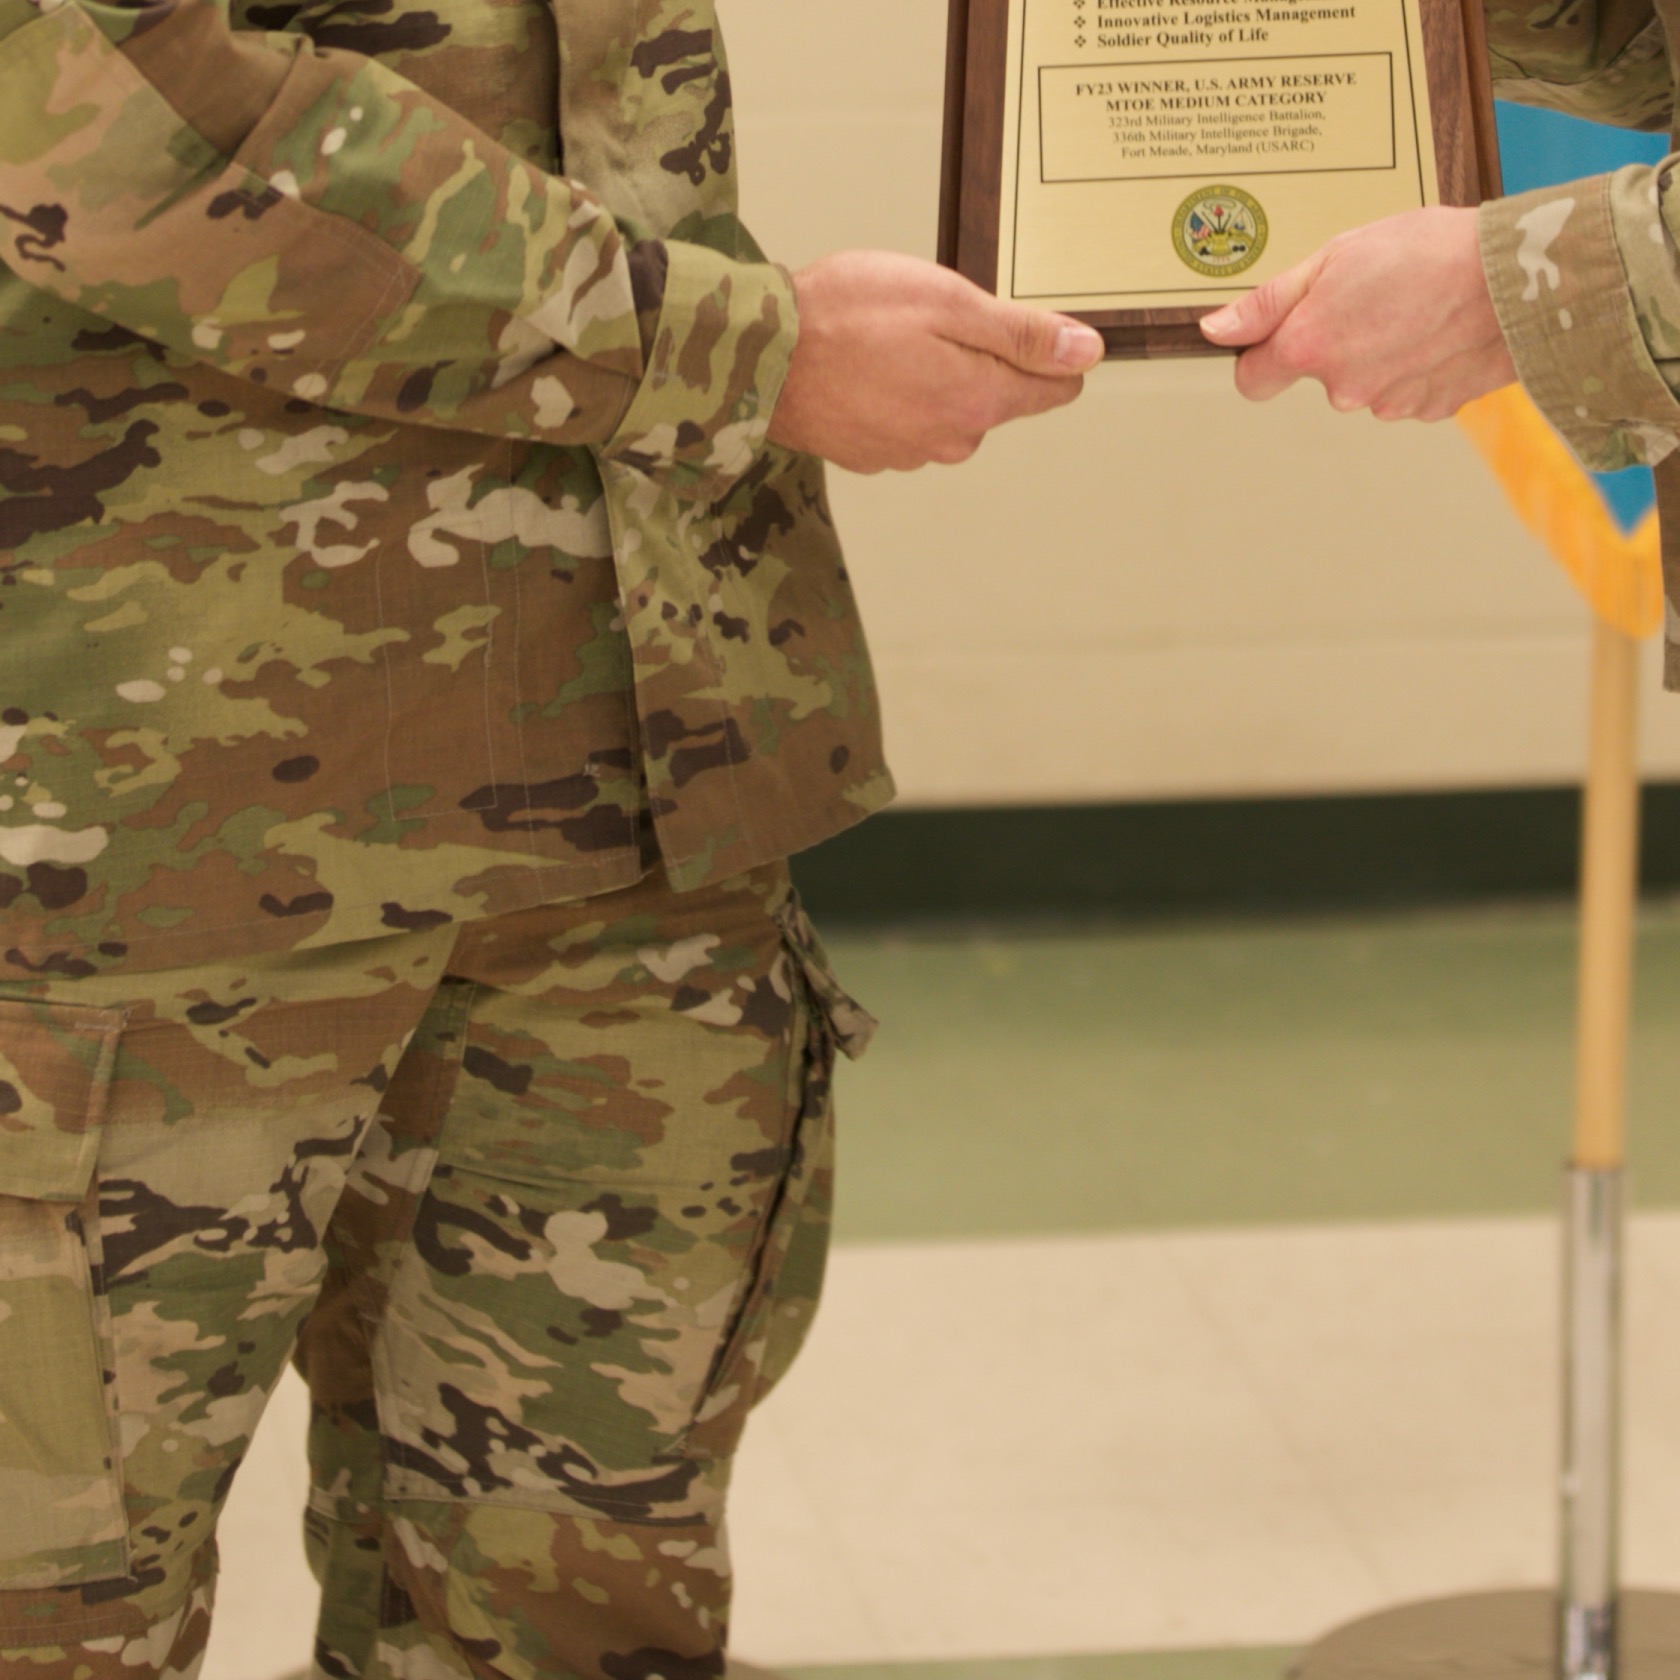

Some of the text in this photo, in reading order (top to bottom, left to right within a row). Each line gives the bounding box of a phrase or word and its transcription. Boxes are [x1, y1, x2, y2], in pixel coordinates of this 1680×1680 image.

[1097, 5, 1356, 28] Innovative Logistics Management
[1097, 26, 1269, 48] Soldier Quality of Life
[1075, 72, 1357, 96] FY23 WINNER, U.S. ARMY RESERVE
[1106, 90, 1327, 112] MTOE MEDIUM CATEGORY
[1108, 108, 1326, 128] 323rd Military Intelligence Battalion,
[1149, 129, 1197, 143] Military
[1200, 125, 1269, 140] Intelligence
[1272, 123, 1323, 139] Brigade,
[1121, 145, 1146, 159] Fort
[1196, 141, 1253, 157] Maryland
[1256, 138, 1315, 155] (USARC)
